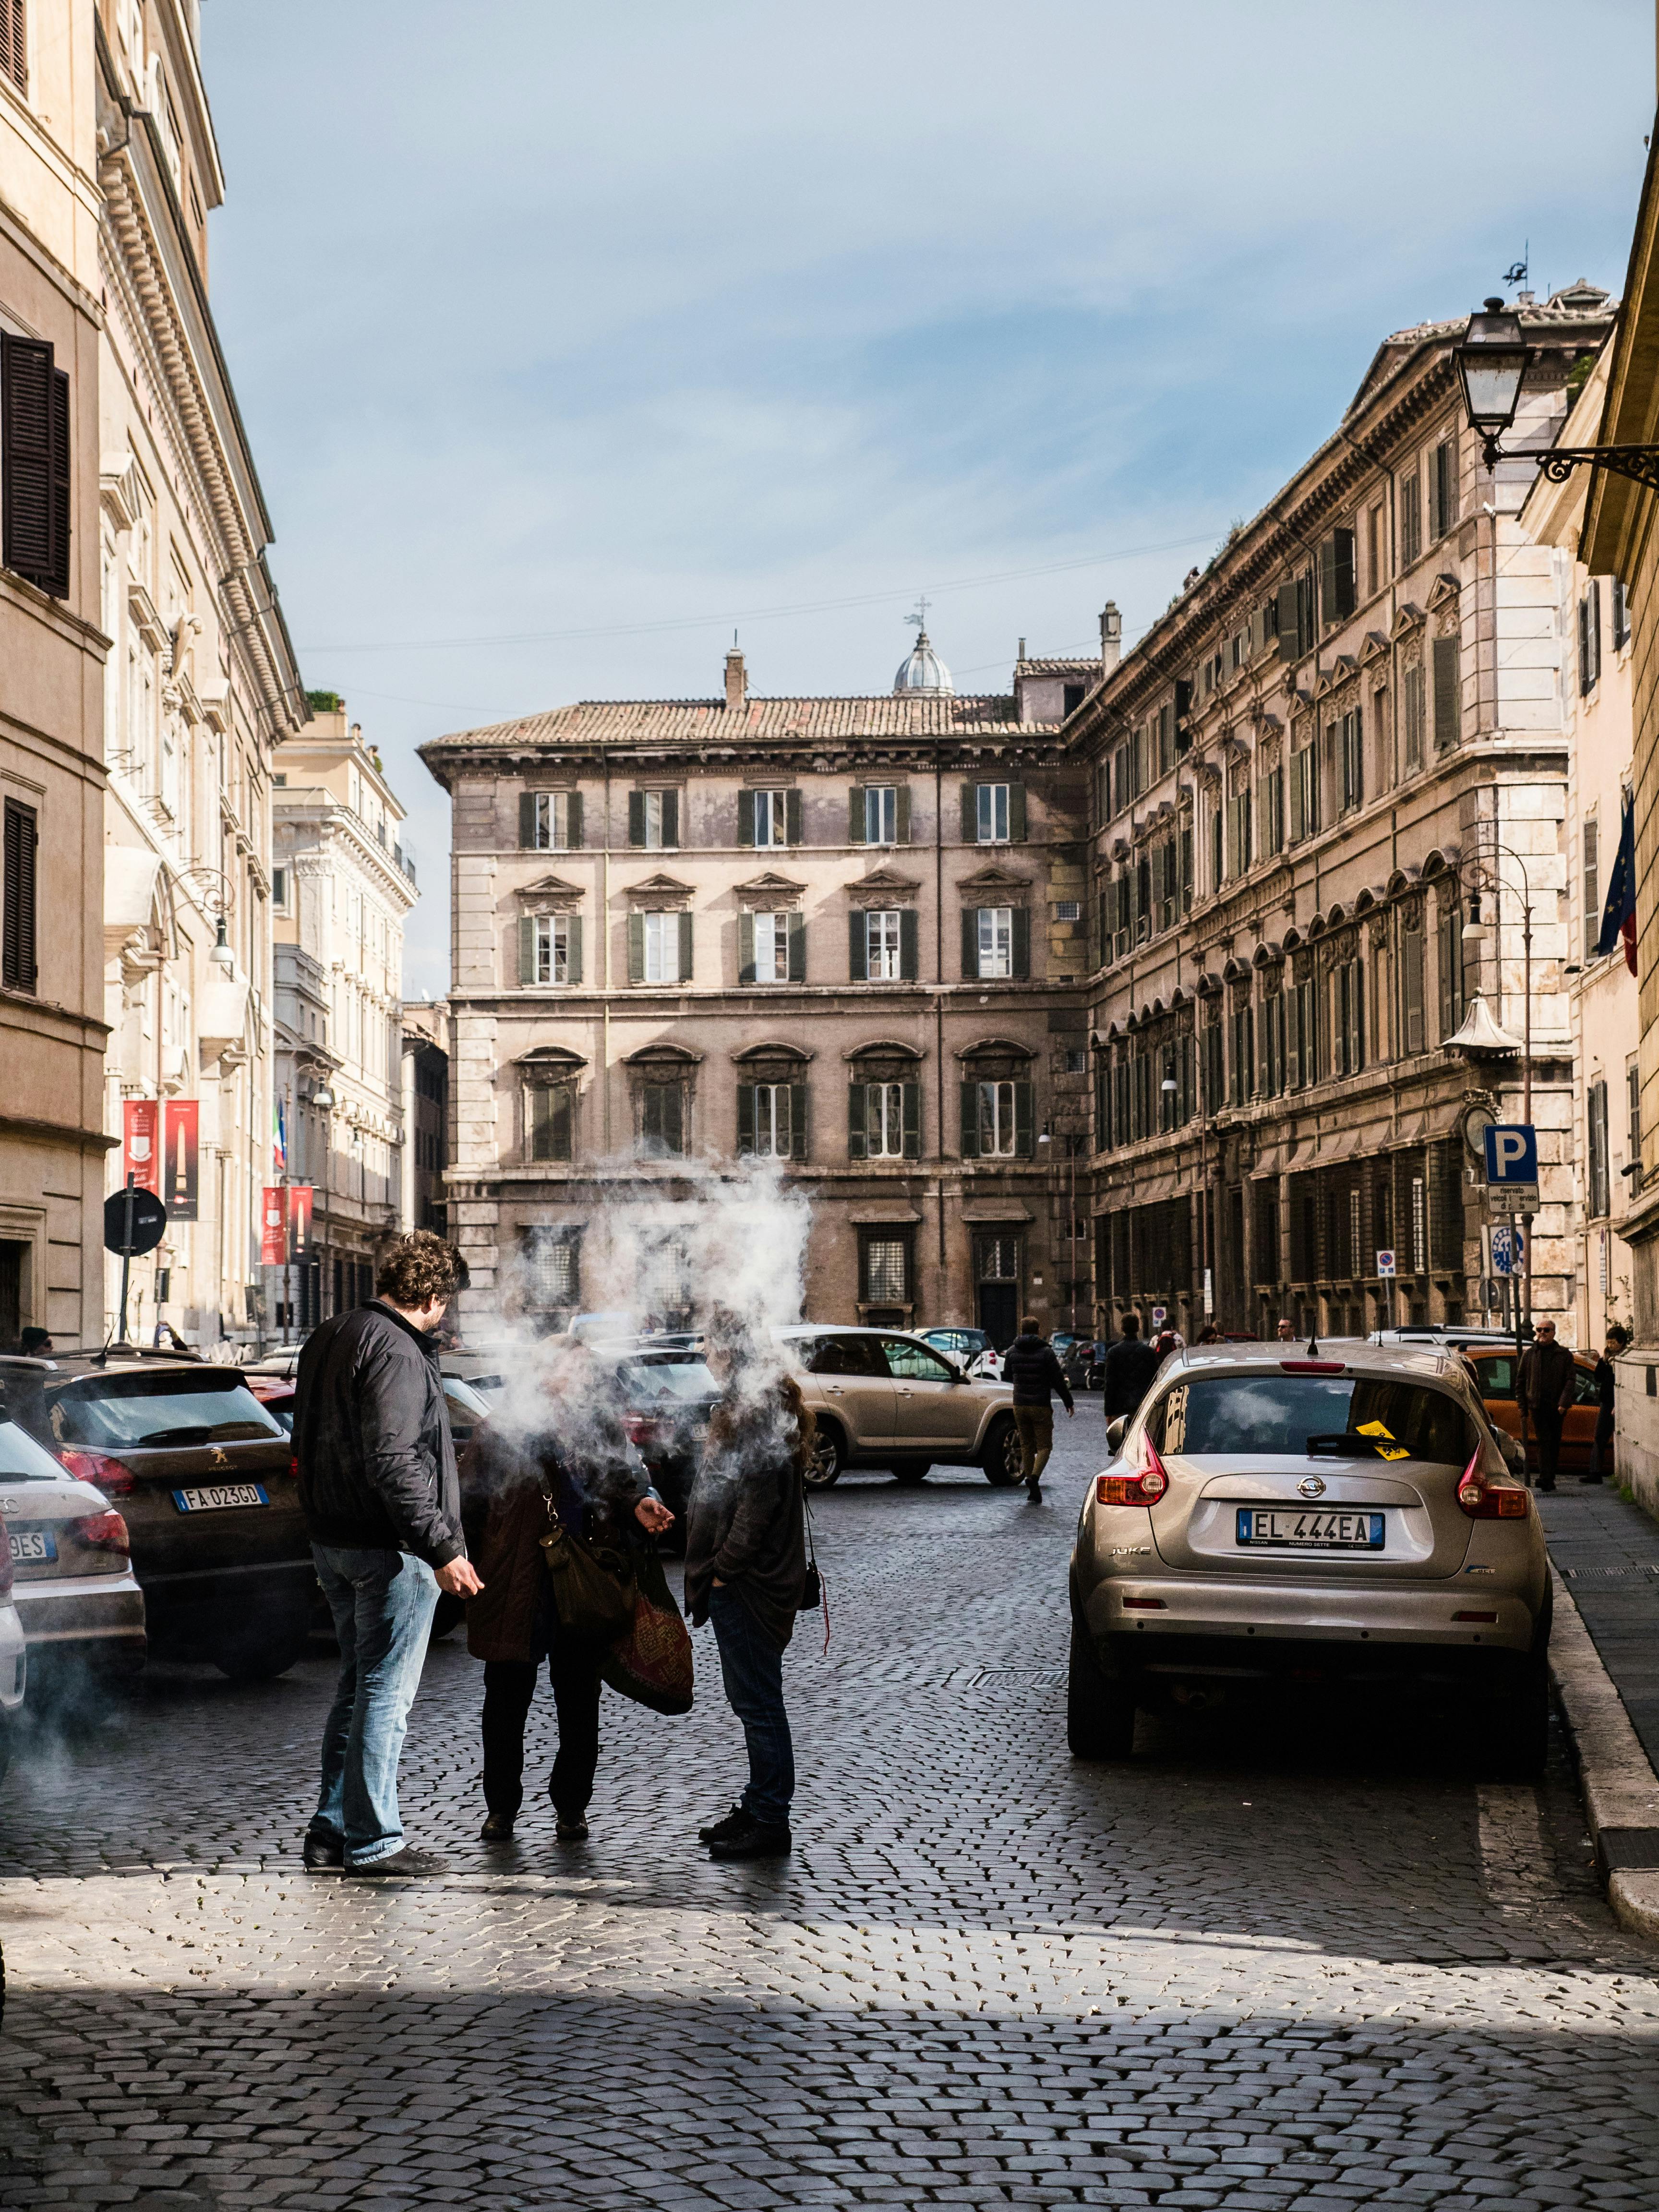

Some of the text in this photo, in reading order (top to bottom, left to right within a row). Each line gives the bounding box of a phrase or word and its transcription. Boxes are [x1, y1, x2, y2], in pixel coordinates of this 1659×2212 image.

[1495, 1131, 1527, 1177] P
[185, 1490, 208, 1508] FA
[209, 1486, 258, 1506] 023GD
[1255, 1513, 1283, 1538] EL
[1294, 1515, 1369, 1541] 444EA
[1108, 1547, 1151, 1556] JUKE
